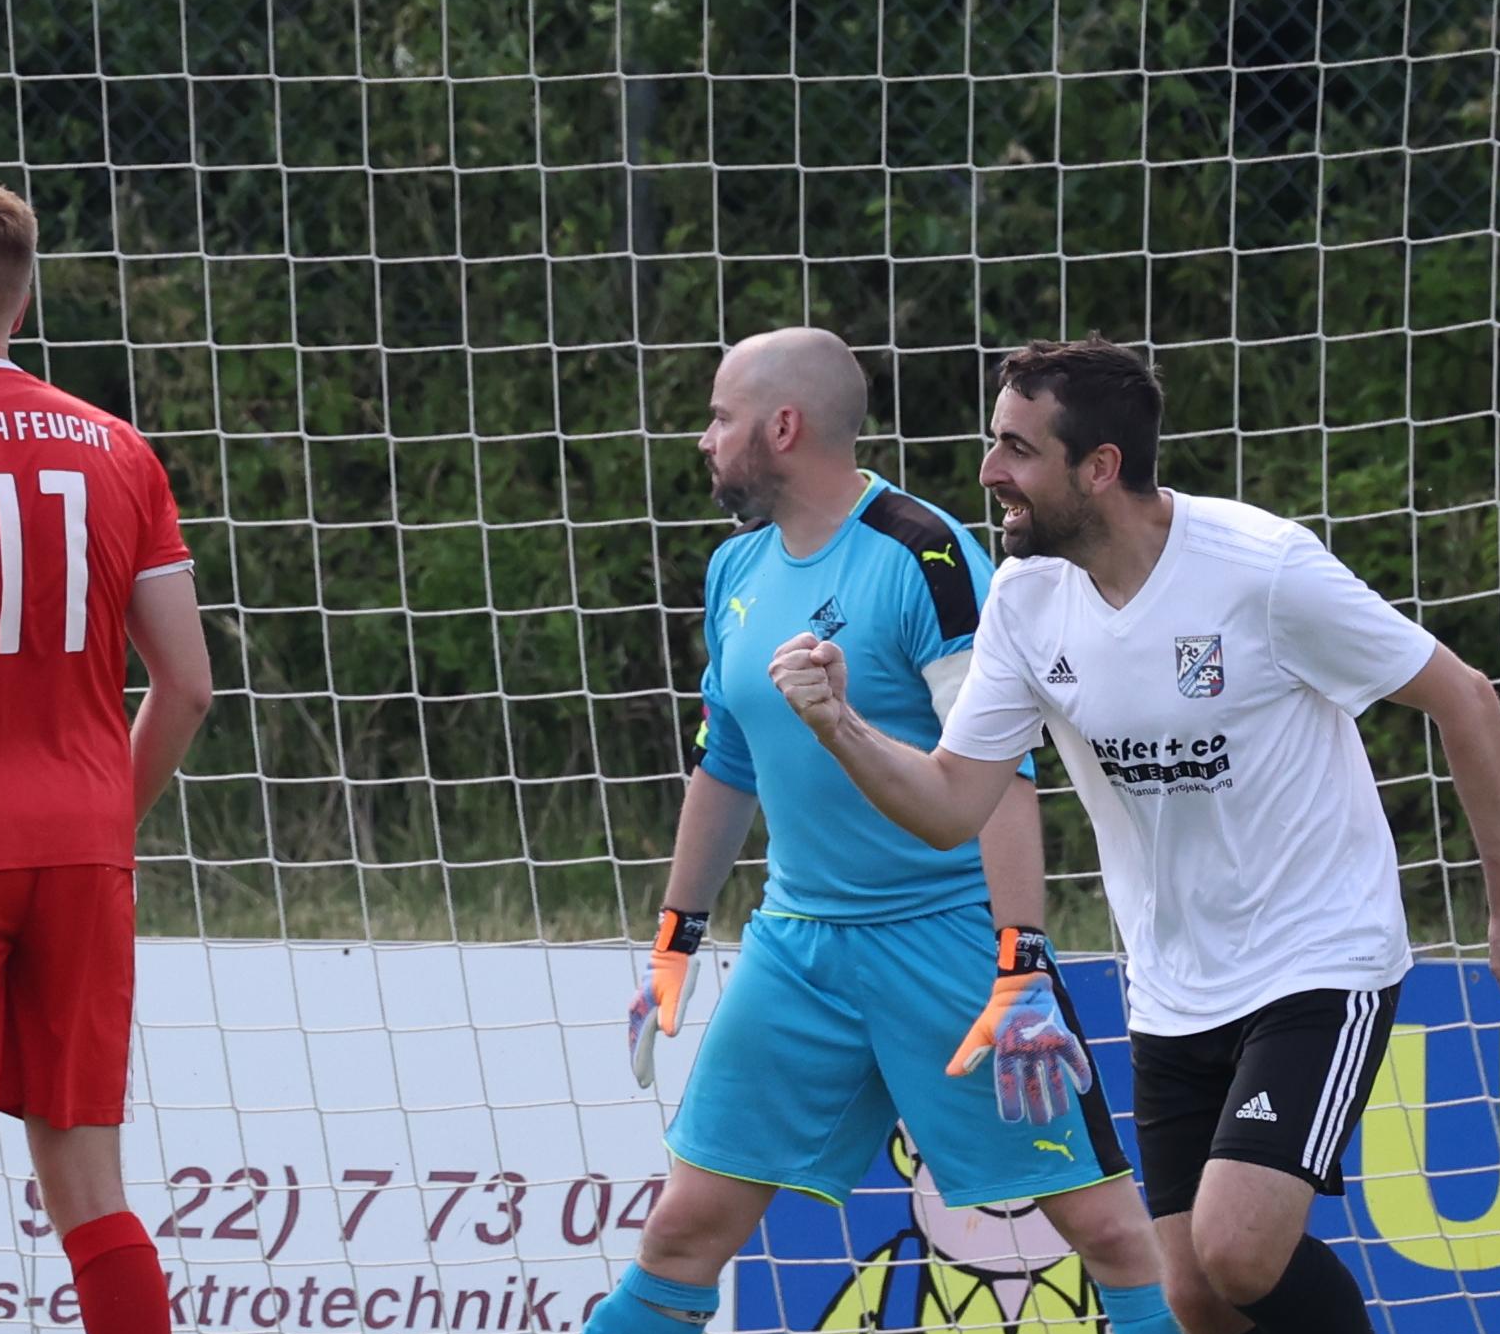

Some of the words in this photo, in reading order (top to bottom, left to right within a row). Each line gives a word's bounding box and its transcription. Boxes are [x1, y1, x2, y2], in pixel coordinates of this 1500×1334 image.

[14, 411, 111, 452] FEUCHT
[1047, 673, 1077, 684] adidas
[1091, 737, 1158, 761] häfer
[1236, 1107, 1277, 1122] adidas
[339, 1169, 394, 1242] 7
[427, 1170, 528, 1246] 73
